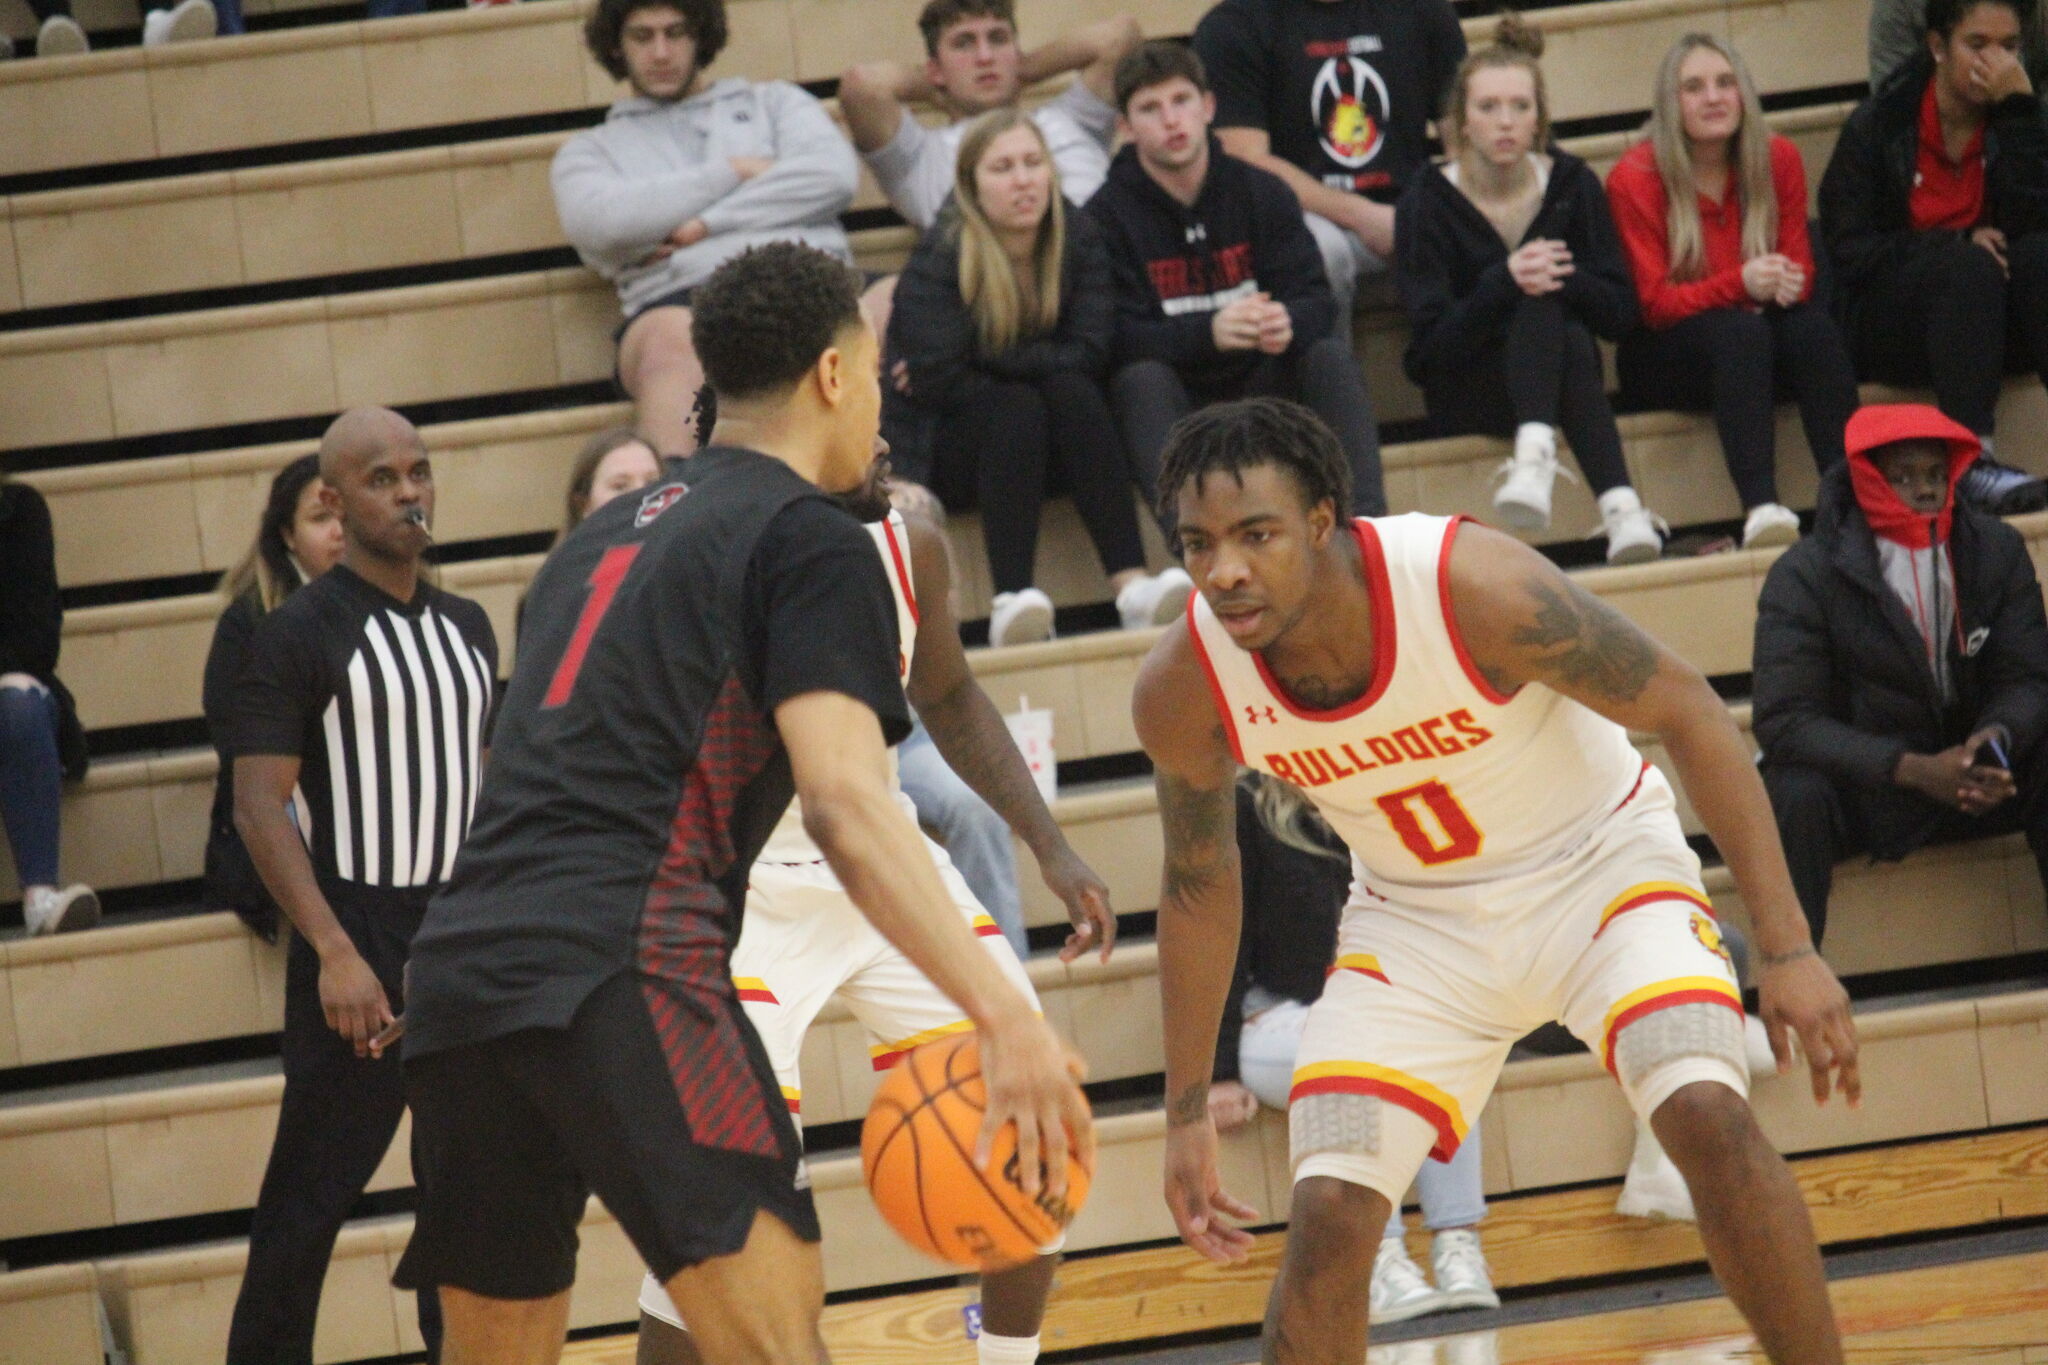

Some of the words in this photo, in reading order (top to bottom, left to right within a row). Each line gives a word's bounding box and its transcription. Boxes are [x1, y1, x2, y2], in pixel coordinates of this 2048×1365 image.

[541, 543, 645, 708] 1
[1264, 708, 1495, 788] BULLDOGS
[1373, 776, 1485, 867] 0
